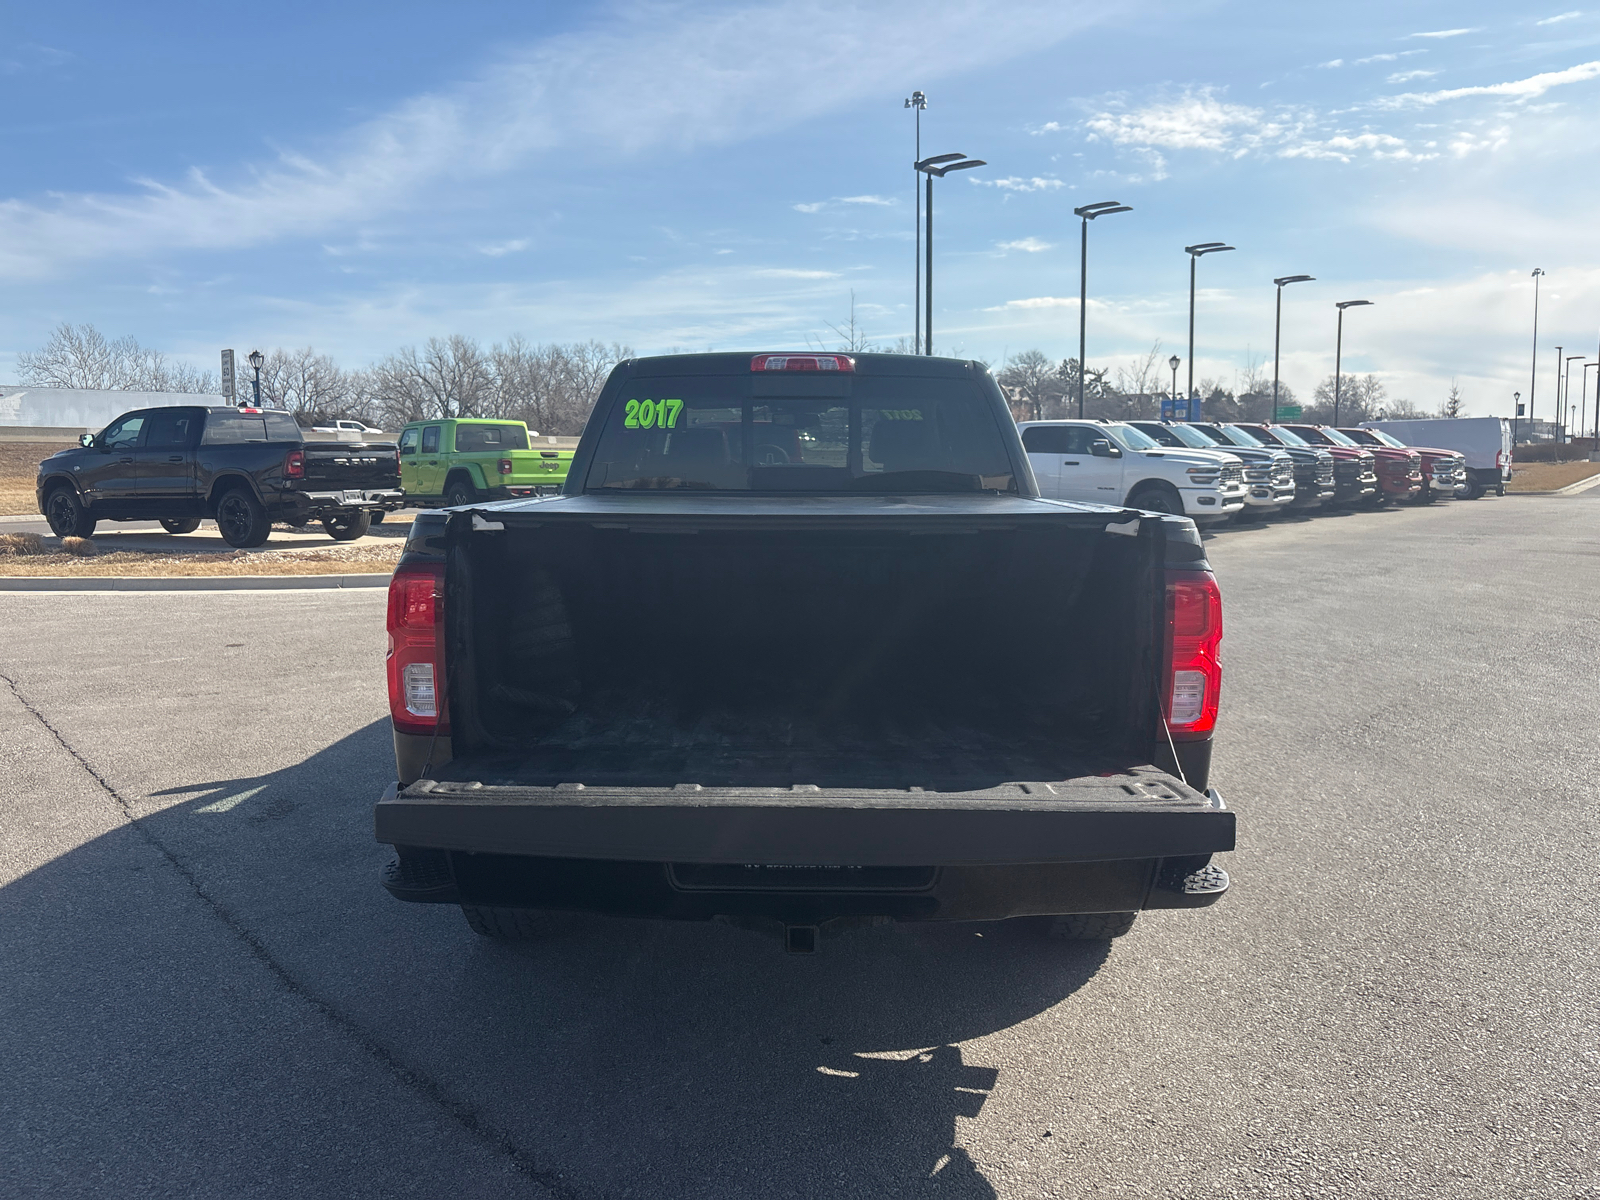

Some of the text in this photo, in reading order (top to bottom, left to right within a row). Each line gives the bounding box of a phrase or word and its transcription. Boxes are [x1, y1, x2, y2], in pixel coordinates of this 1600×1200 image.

[624, 399, 684, 429] 2017
[333, 458, 377, 466] RAM
[539, 461, 560, 470] Jeep
